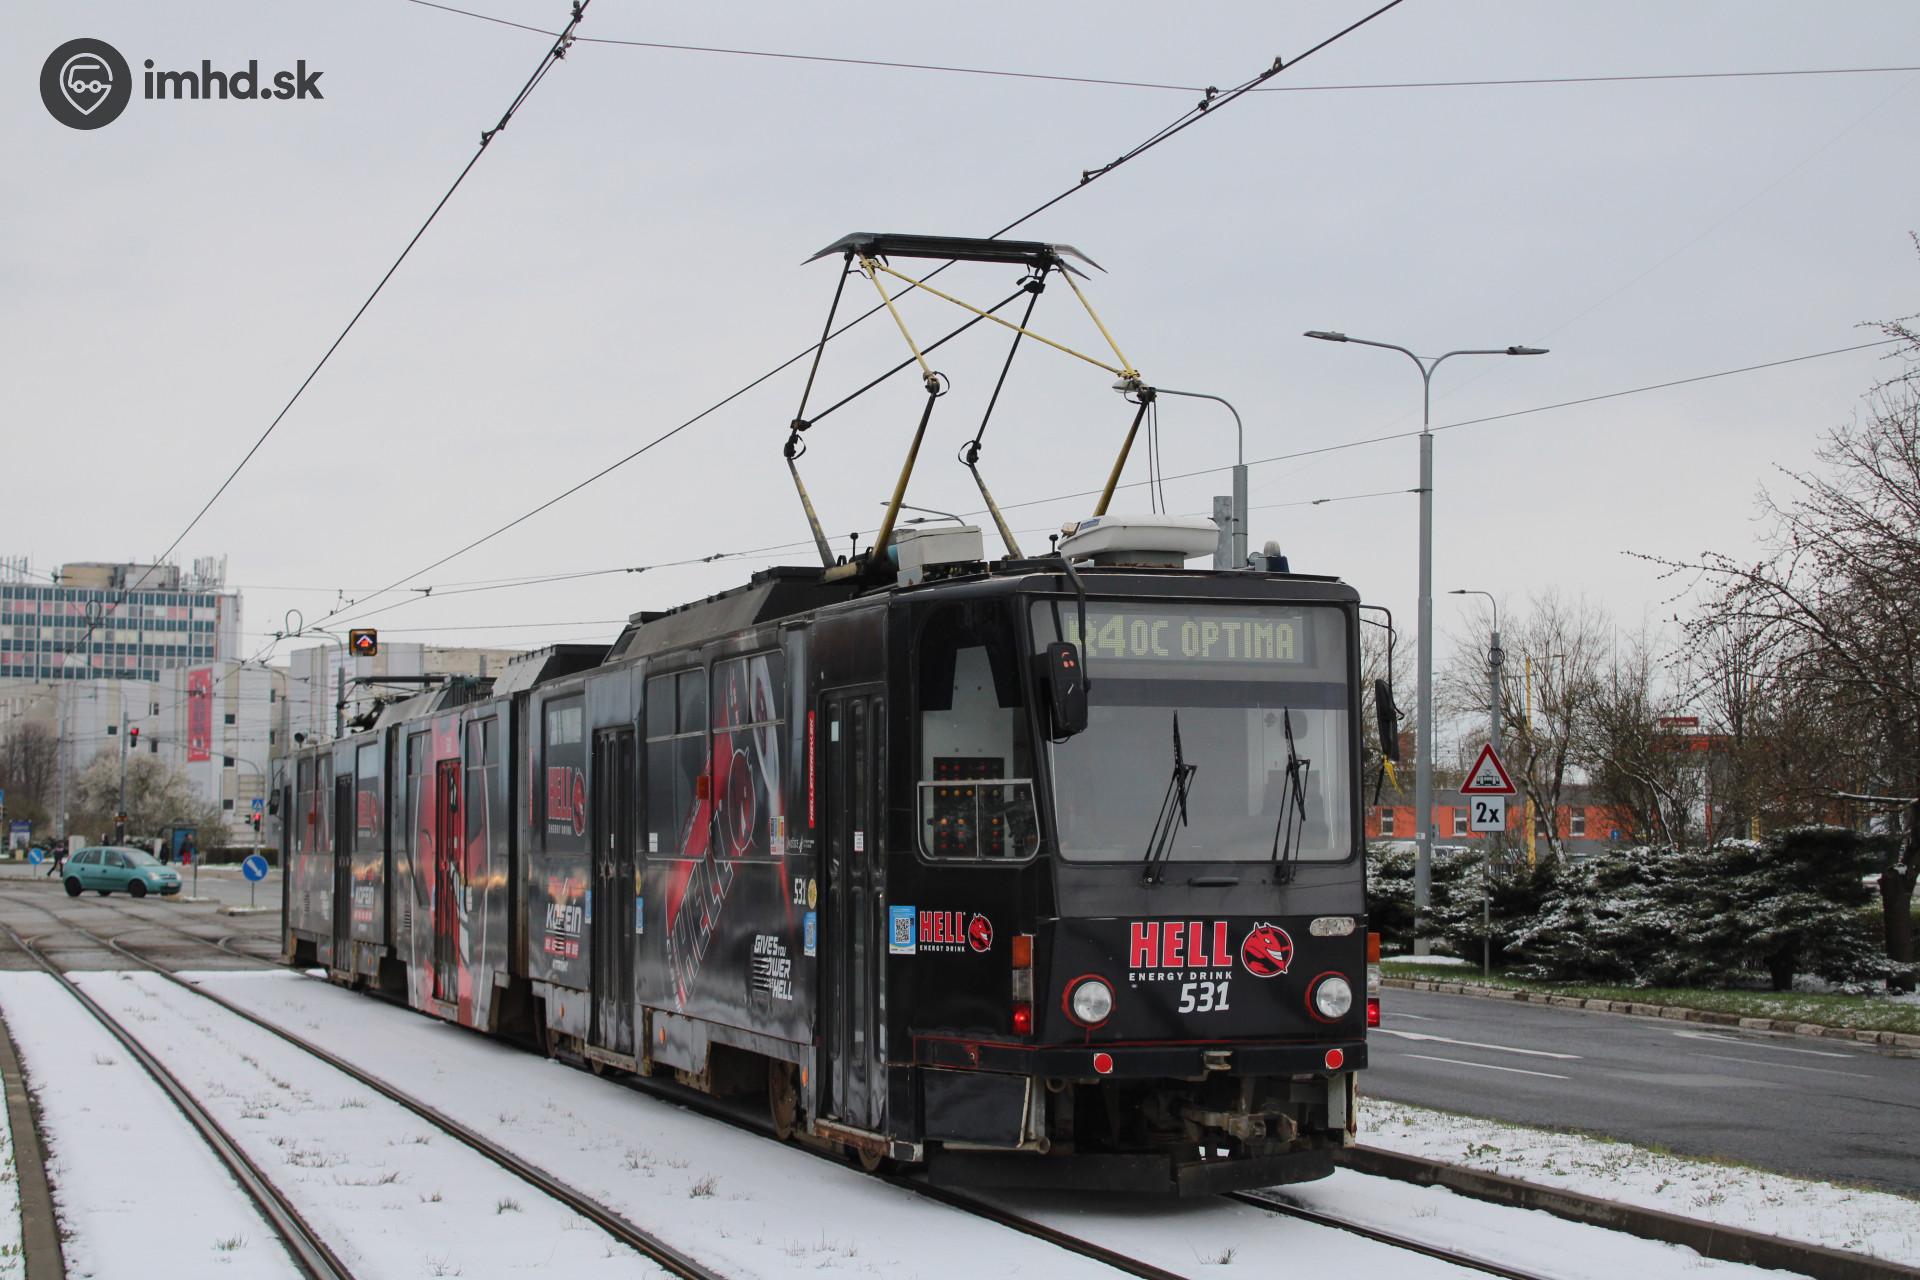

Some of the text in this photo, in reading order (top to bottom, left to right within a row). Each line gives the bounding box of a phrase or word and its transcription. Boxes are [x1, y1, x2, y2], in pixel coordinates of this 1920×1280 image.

[1130, 619, 1169, 656] OC
[1181, 621, 1295, 659] OPTIMA
[1476, 802, 1500, 823] 2x
[793, 878, 807, 905] 531
[919, 911, 966, 943] HELL
[753, 934, 779, 956] GIVES
[919, 944, 944, 953] ENERGY
[945, 944, 966, 953] DRINK
[1129, 921, 1233, 968] HELL
[759, 957, 792, 980] OWER
[1128, 971, 1233, 982] ENERGY DRINK
[772, 979, 793, 1001] HELL
[1177, 981, 1230, 1014] 531
